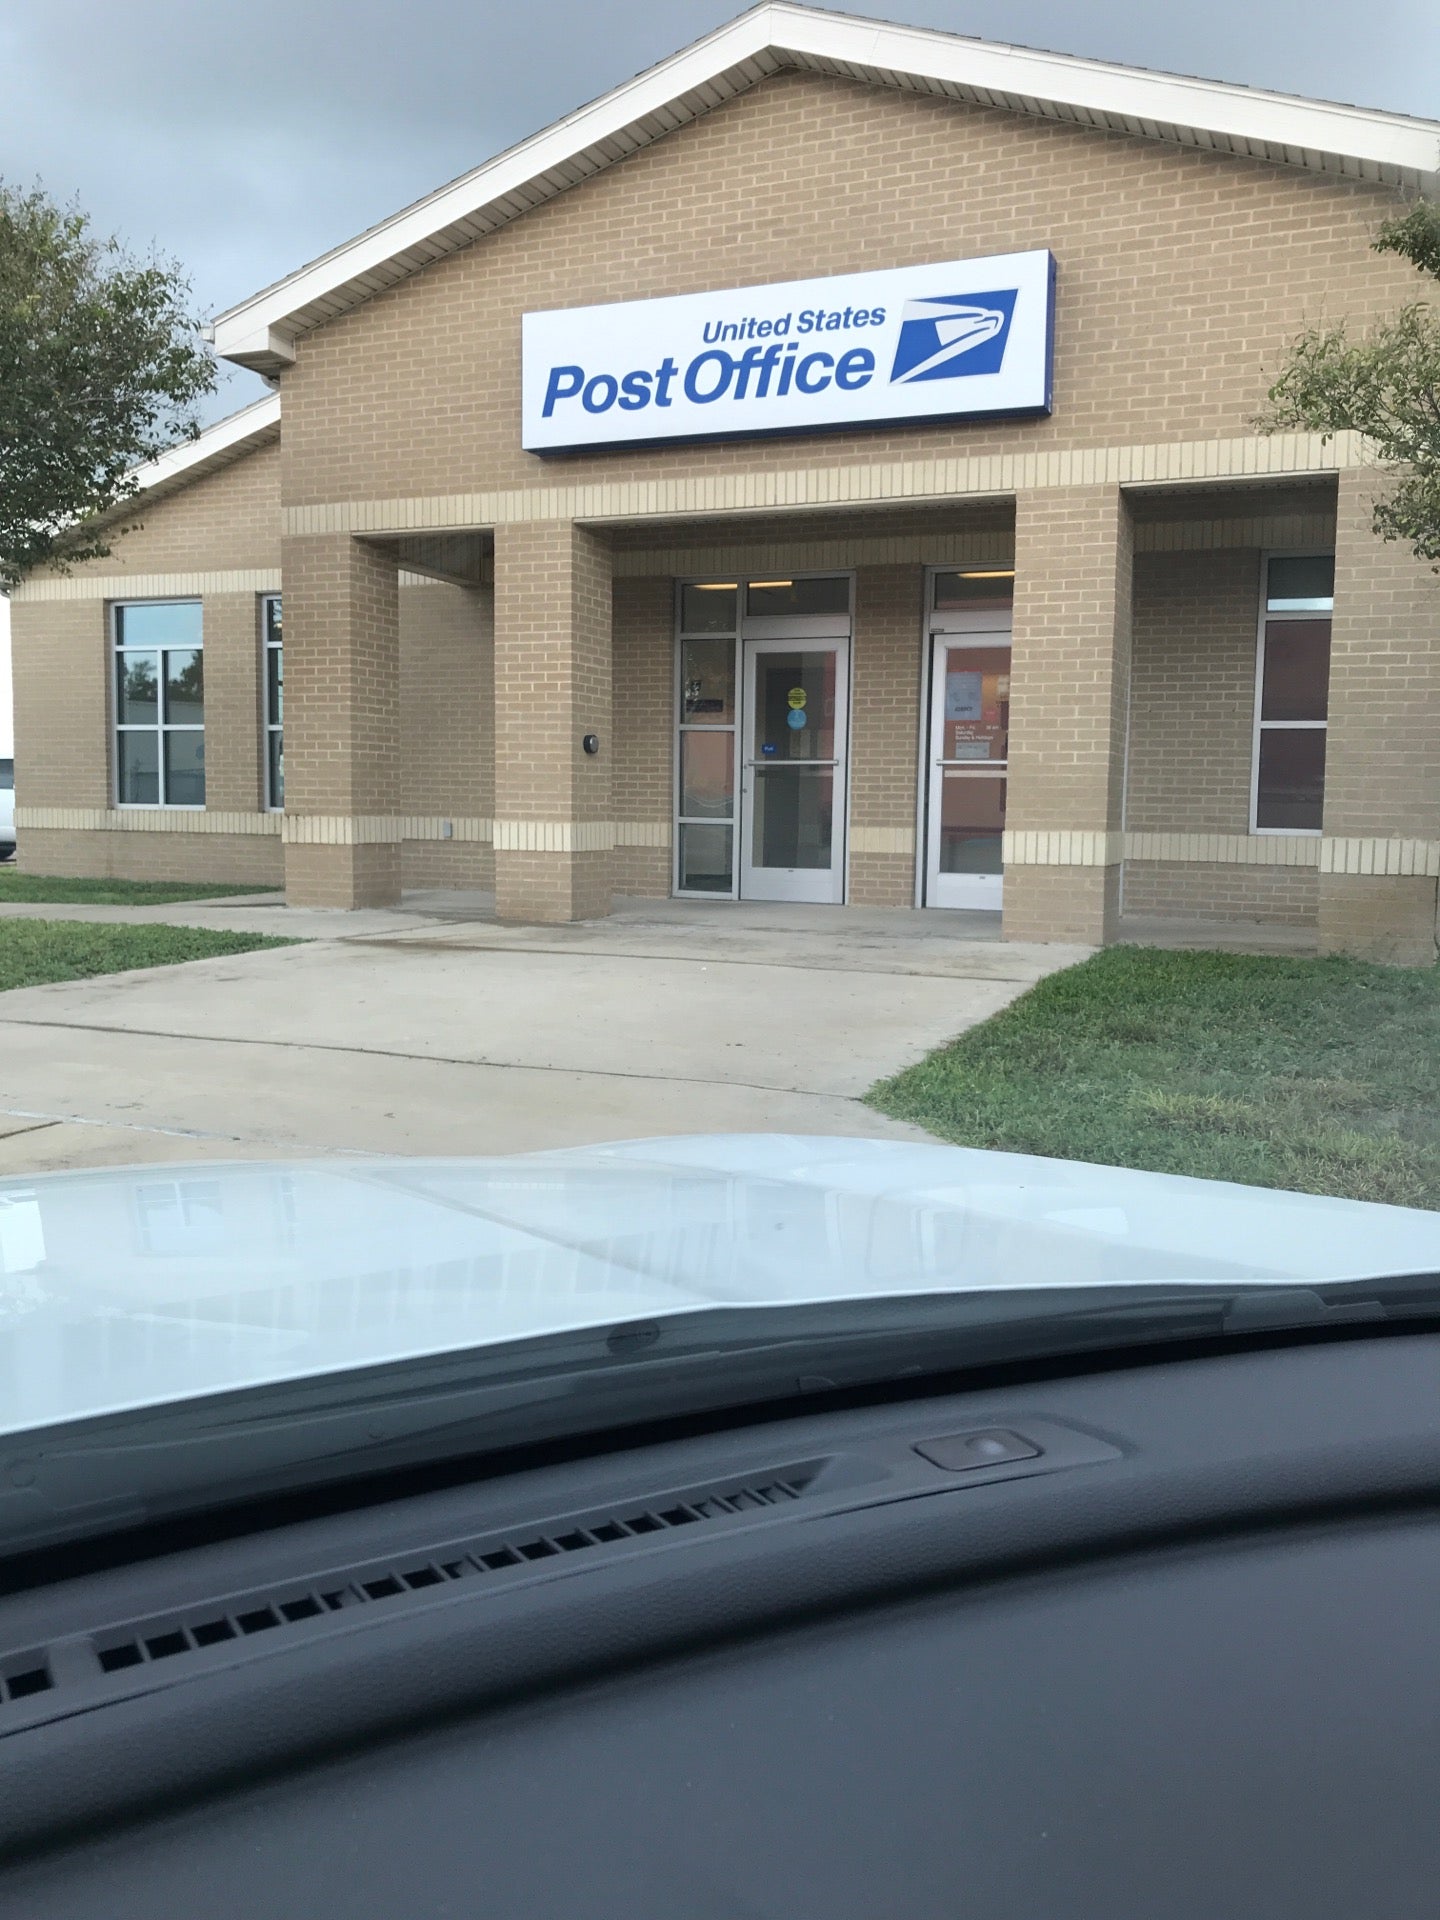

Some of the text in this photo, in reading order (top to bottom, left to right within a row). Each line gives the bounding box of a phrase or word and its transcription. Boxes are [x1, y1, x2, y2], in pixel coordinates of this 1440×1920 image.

[702, 306, 886, 344] United States
[542, 342, 876, 418] Post Office
